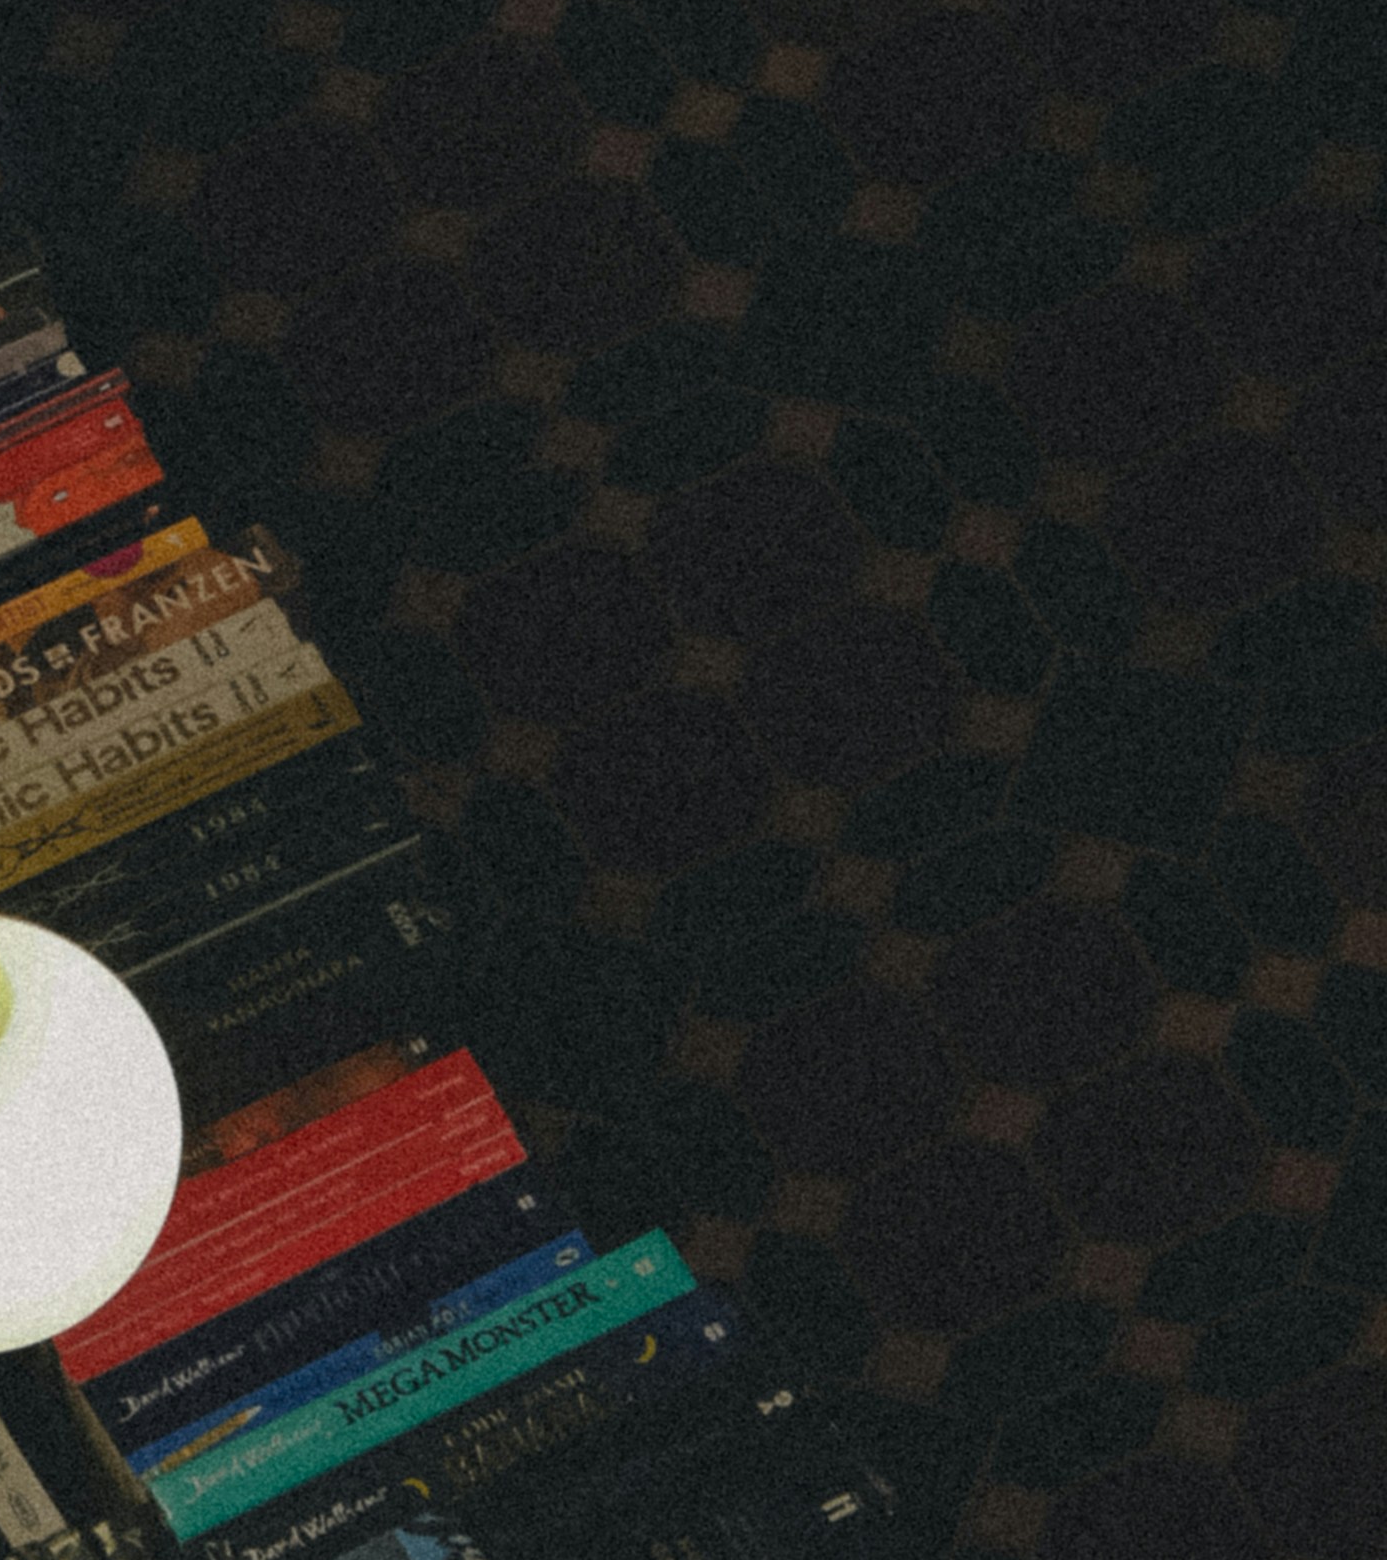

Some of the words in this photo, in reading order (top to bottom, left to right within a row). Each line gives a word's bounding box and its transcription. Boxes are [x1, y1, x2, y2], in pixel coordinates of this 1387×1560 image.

[77, 543, 275, 659] FRANZEN
[16, 646, 184, 750] Habits
[55, 693, 222, 797] Habits
[189, 796, 268, 845] 1984
[200, 852, 283, 901] 1984
